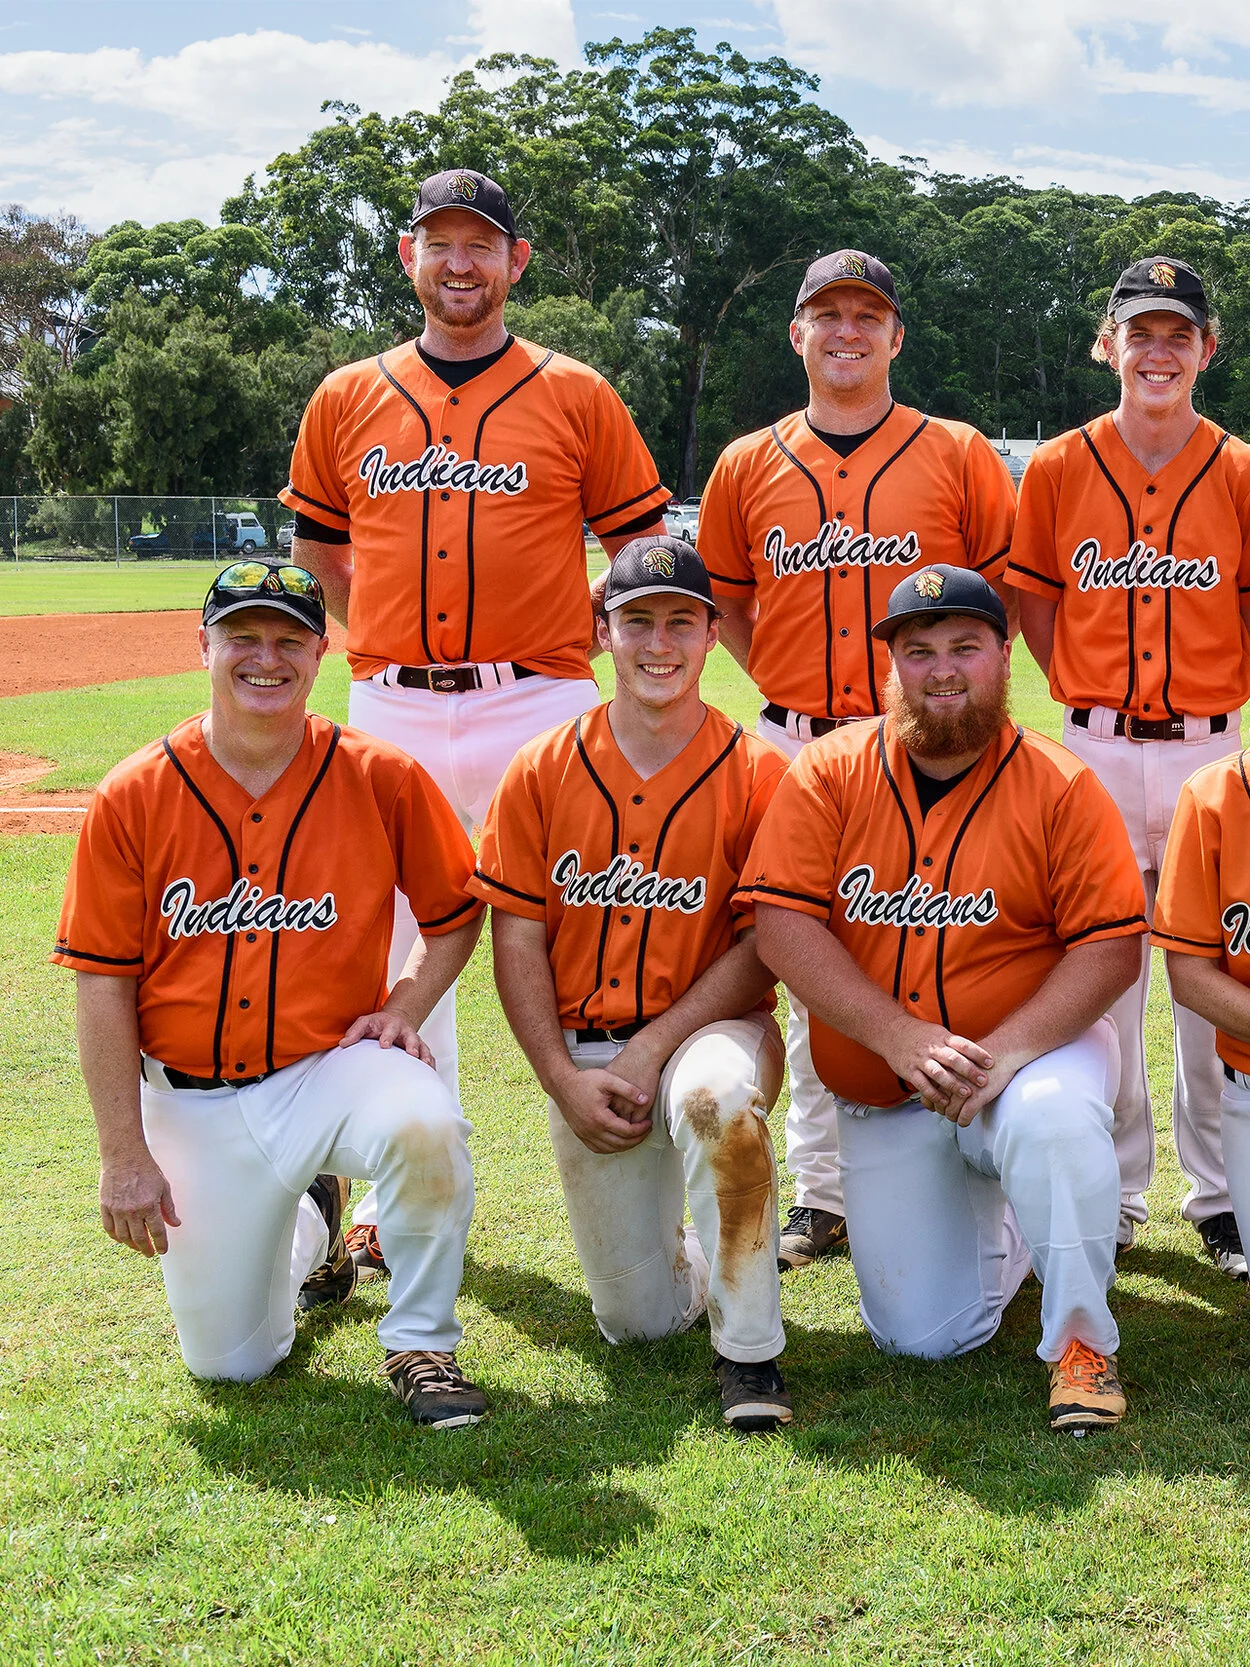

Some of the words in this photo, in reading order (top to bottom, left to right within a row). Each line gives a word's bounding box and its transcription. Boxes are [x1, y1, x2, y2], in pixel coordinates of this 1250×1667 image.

[358, 443, 529, 500] Indians
[763, 518, 921, 578] Indians
[1071, 537, 1221, 592] Indians
[161, 877, 338, 941] Indians
[551, 848, 708, 914] Indians
[837, 863, 998, 928] Indians
